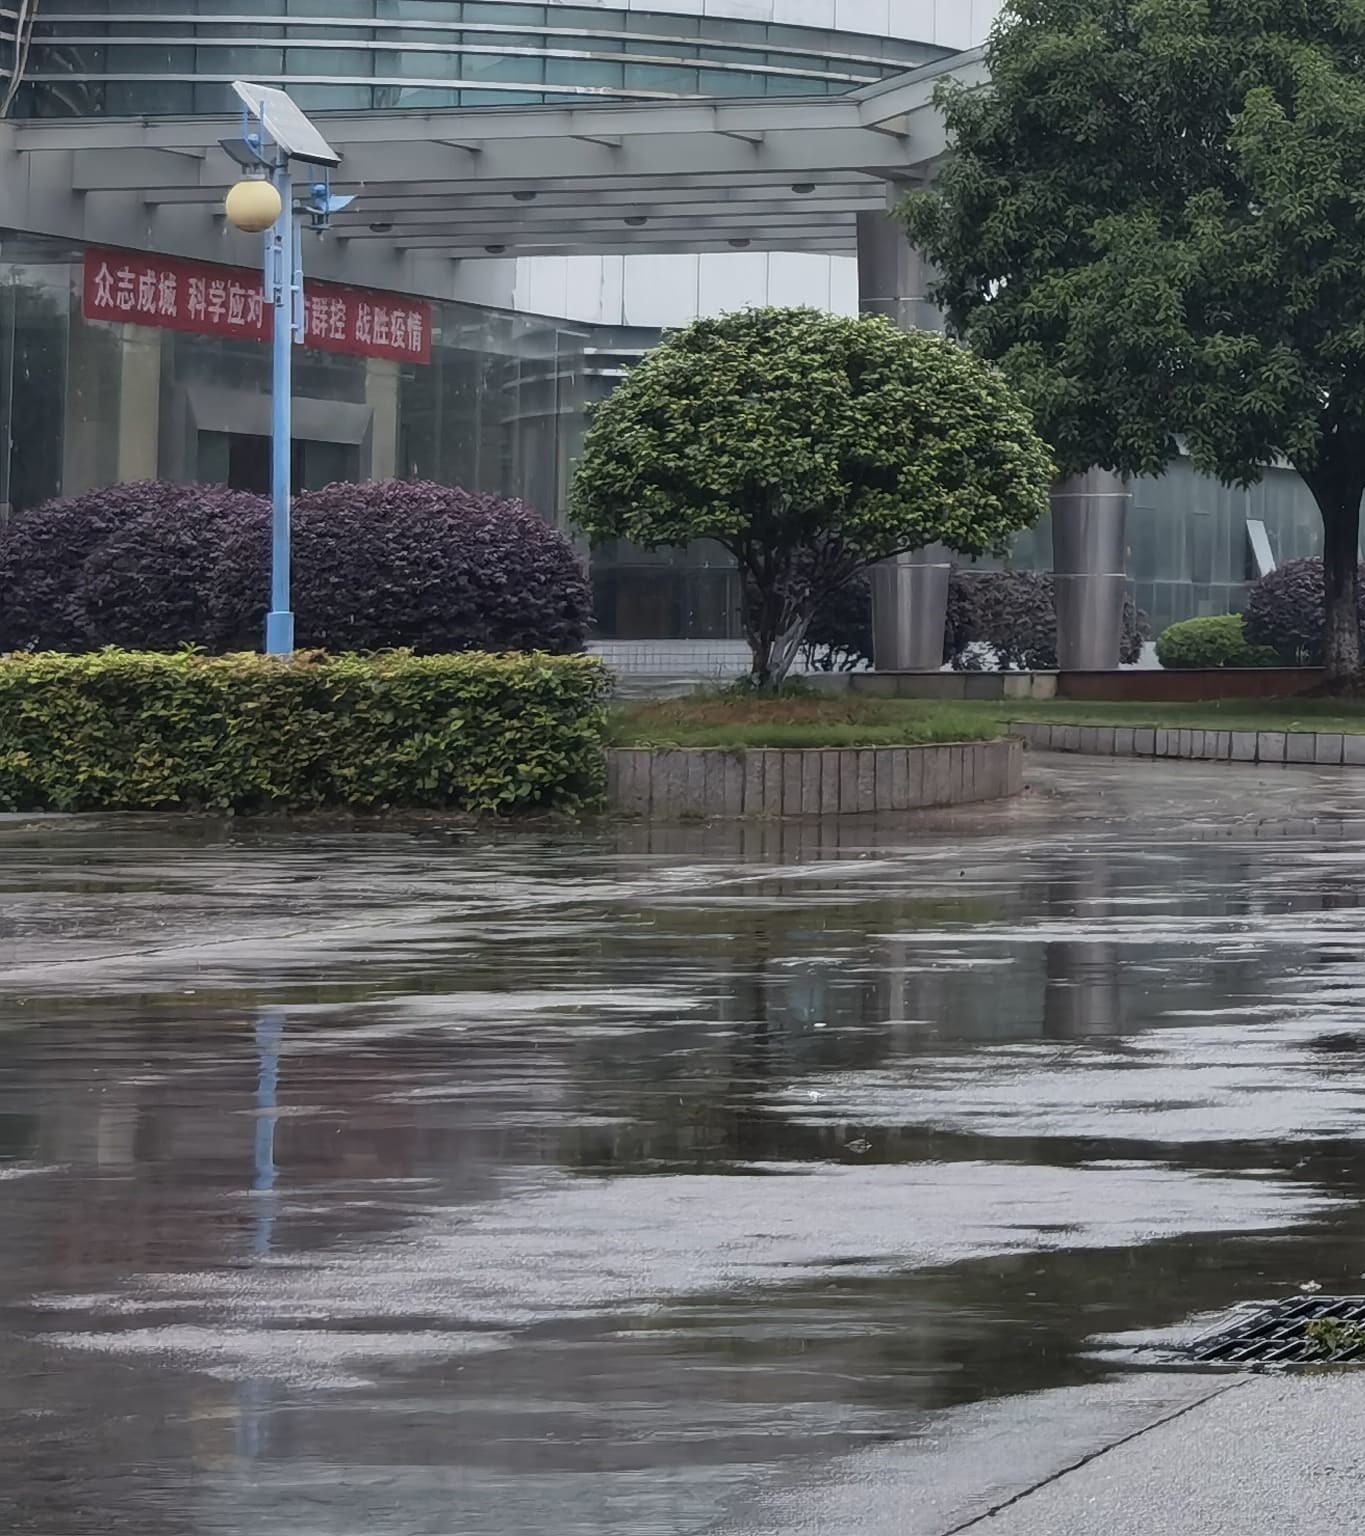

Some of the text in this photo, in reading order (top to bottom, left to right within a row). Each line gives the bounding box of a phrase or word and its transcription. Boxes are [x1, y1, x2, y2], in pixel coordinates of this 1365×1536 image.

[94, 262, 177, 317] 众志成城
[187, 277, 263, 329] 科学应对
[355, 302, 424, 352] 战胜疫情
